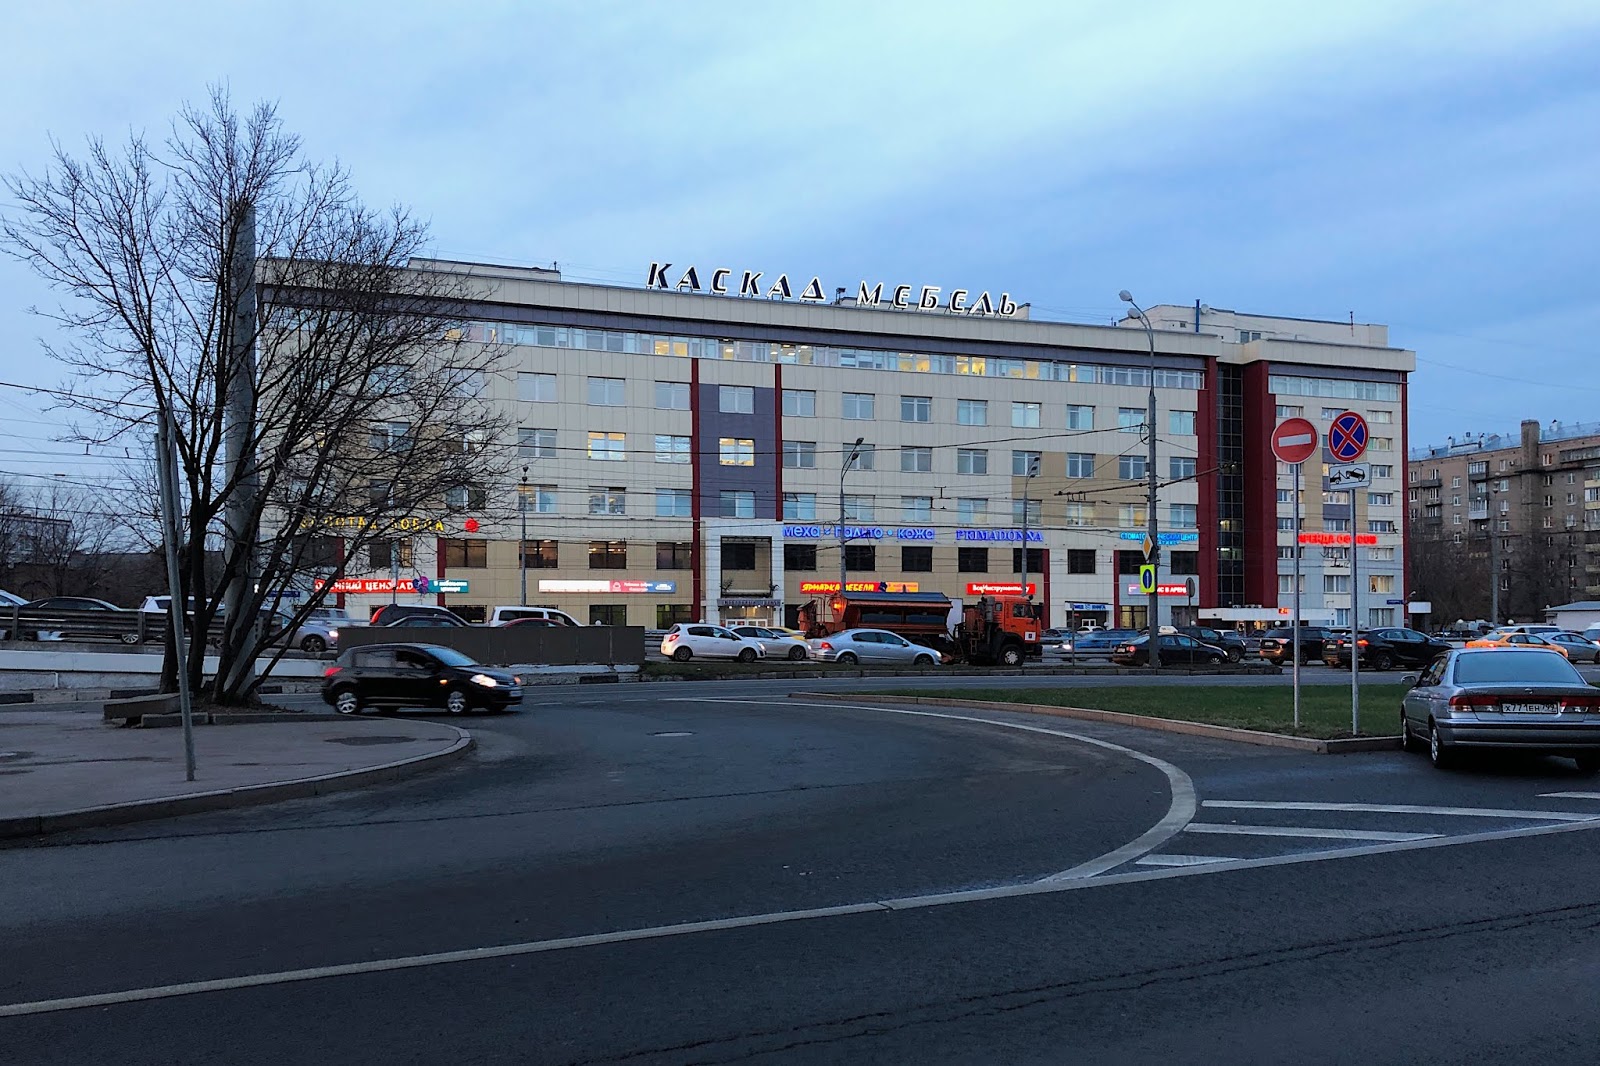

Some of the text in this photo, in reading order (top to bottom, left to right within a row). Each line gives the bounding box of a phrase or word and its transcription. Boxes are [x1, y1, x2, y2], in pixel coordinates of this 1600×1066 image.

[646, 261, 1018, 317] КАСКАД МЕБЕЛЬ
[897, 528, 935, 540] кожа
[956, 529, 1043, 541] PRIMADONNA
[802, 583, 841, 592] ЯРМАРКА
